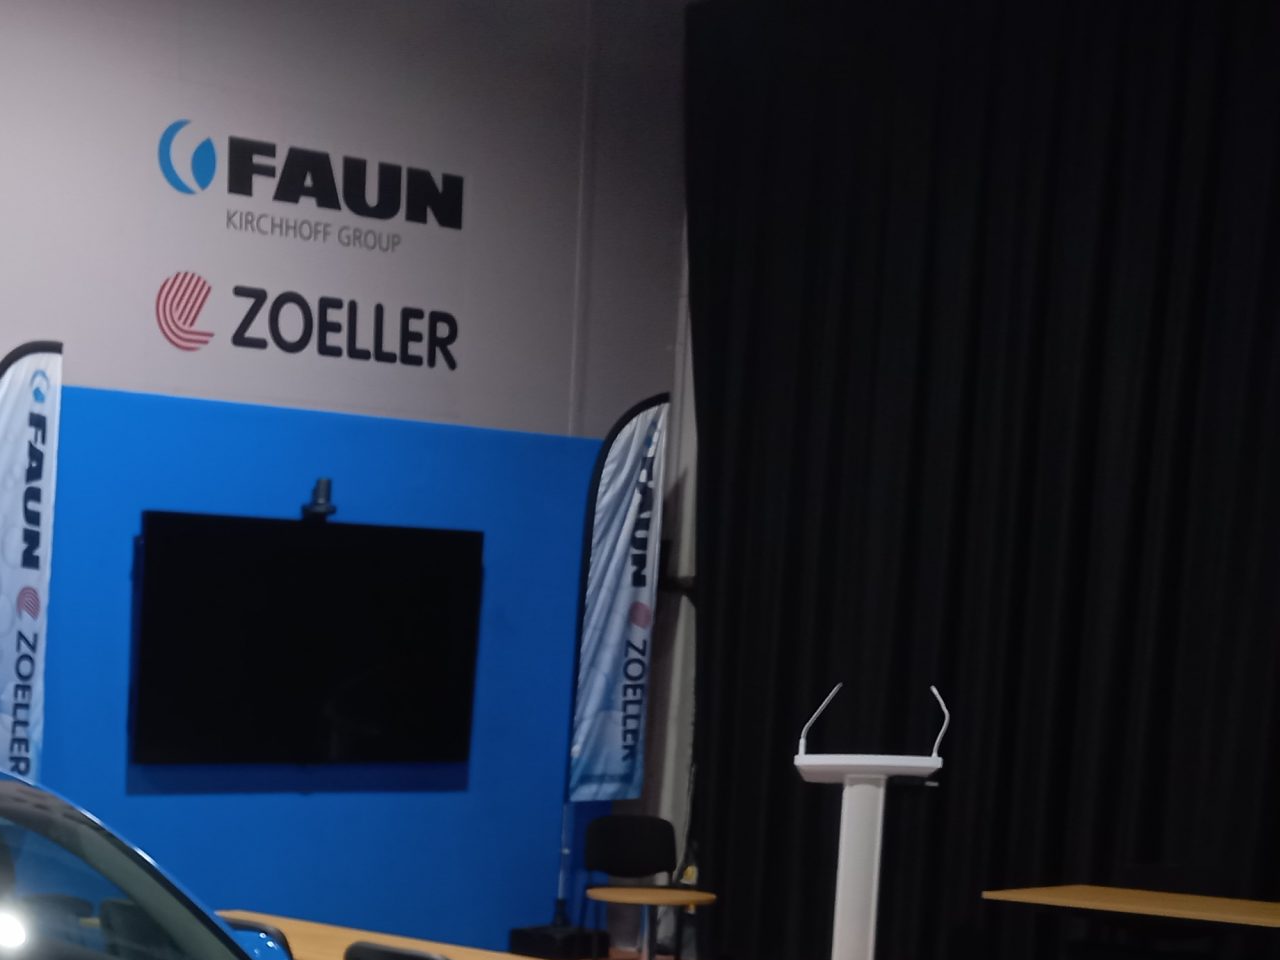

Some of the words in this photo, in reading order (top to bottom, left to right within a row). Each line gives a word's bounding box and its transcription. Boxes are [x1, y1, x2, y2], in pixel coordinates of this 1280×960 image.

[225, 207, 332, 244] KIRCHHOFF
[337, 224, 402, 252] GROUP
[227, 135, 464, 230] FAUN
[231, 285, 459, 371] ZOELLER
[21, 412, 47, 571] FAUN
[8, 631, 39, 778] ZOELLER
